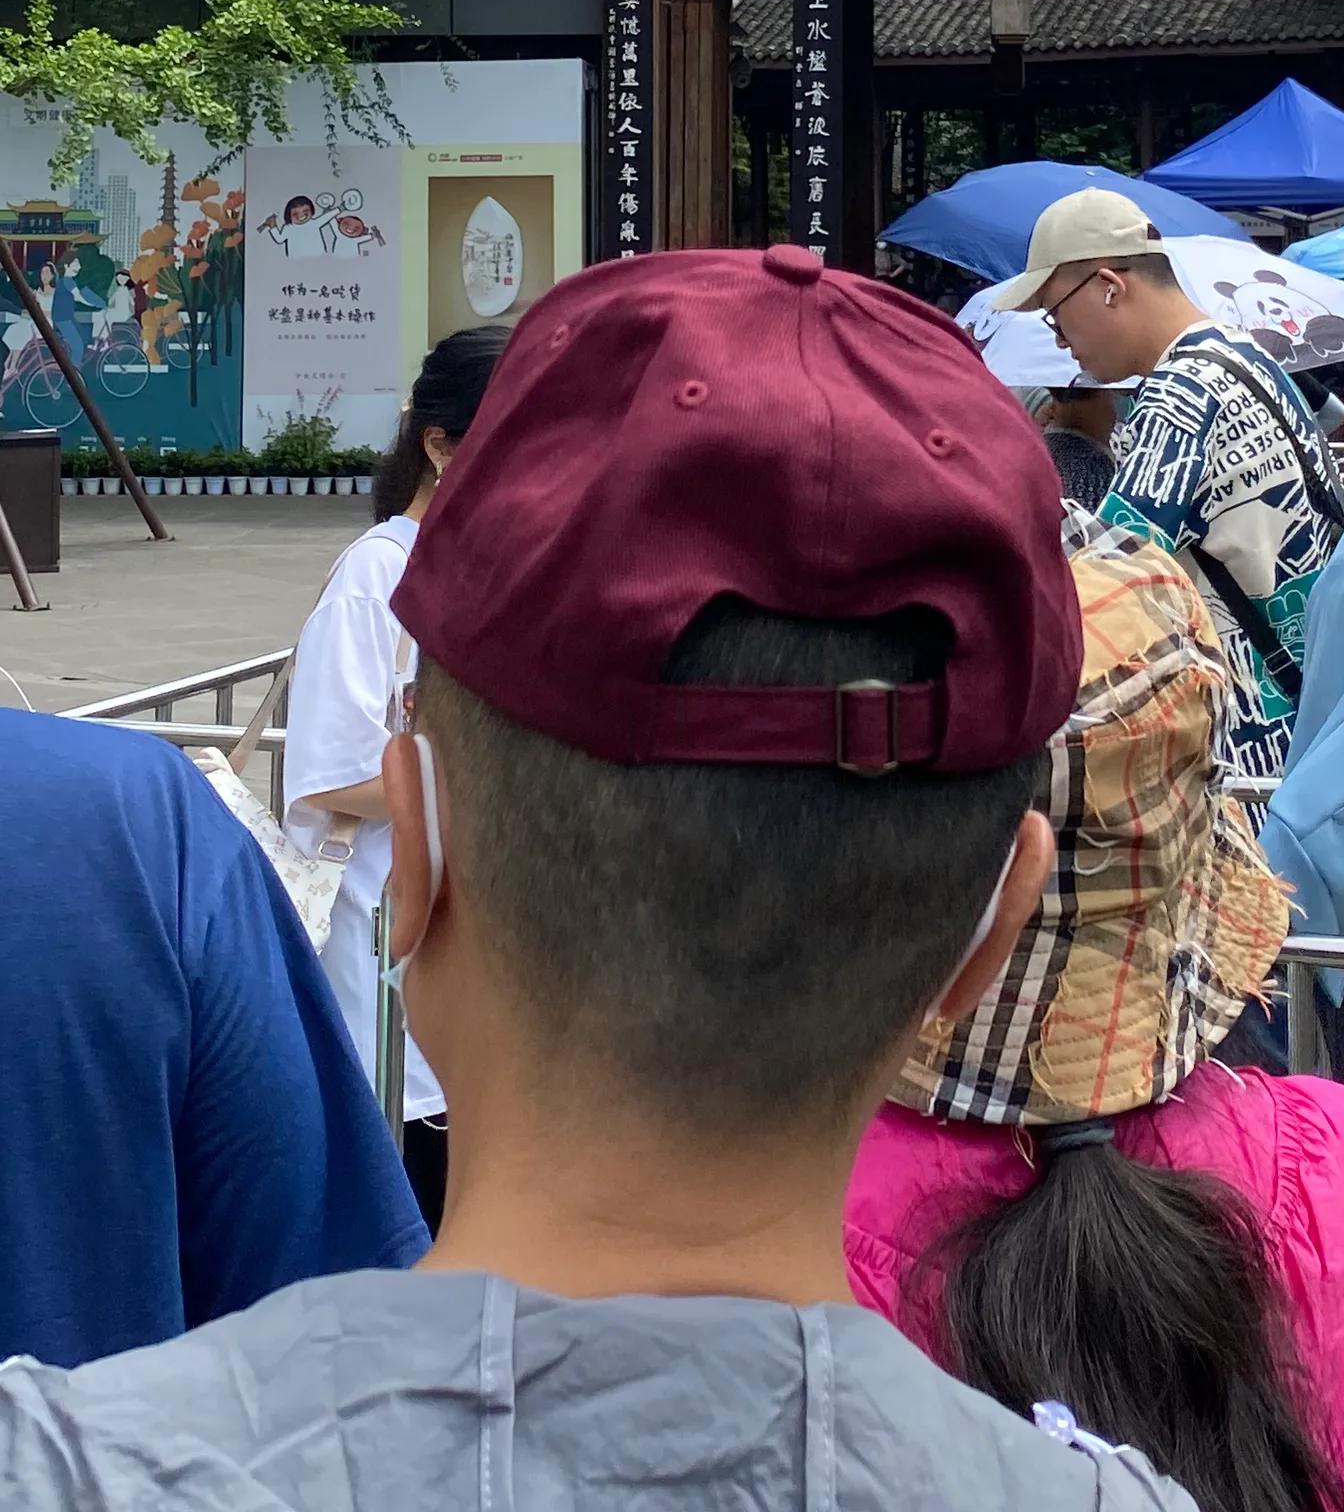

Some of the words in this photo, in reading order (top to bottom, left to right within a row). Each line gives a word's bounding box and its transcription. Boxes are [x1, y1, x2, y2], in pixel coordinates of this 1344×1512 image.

[281, 281, 361, 301] 作为一名吃货
